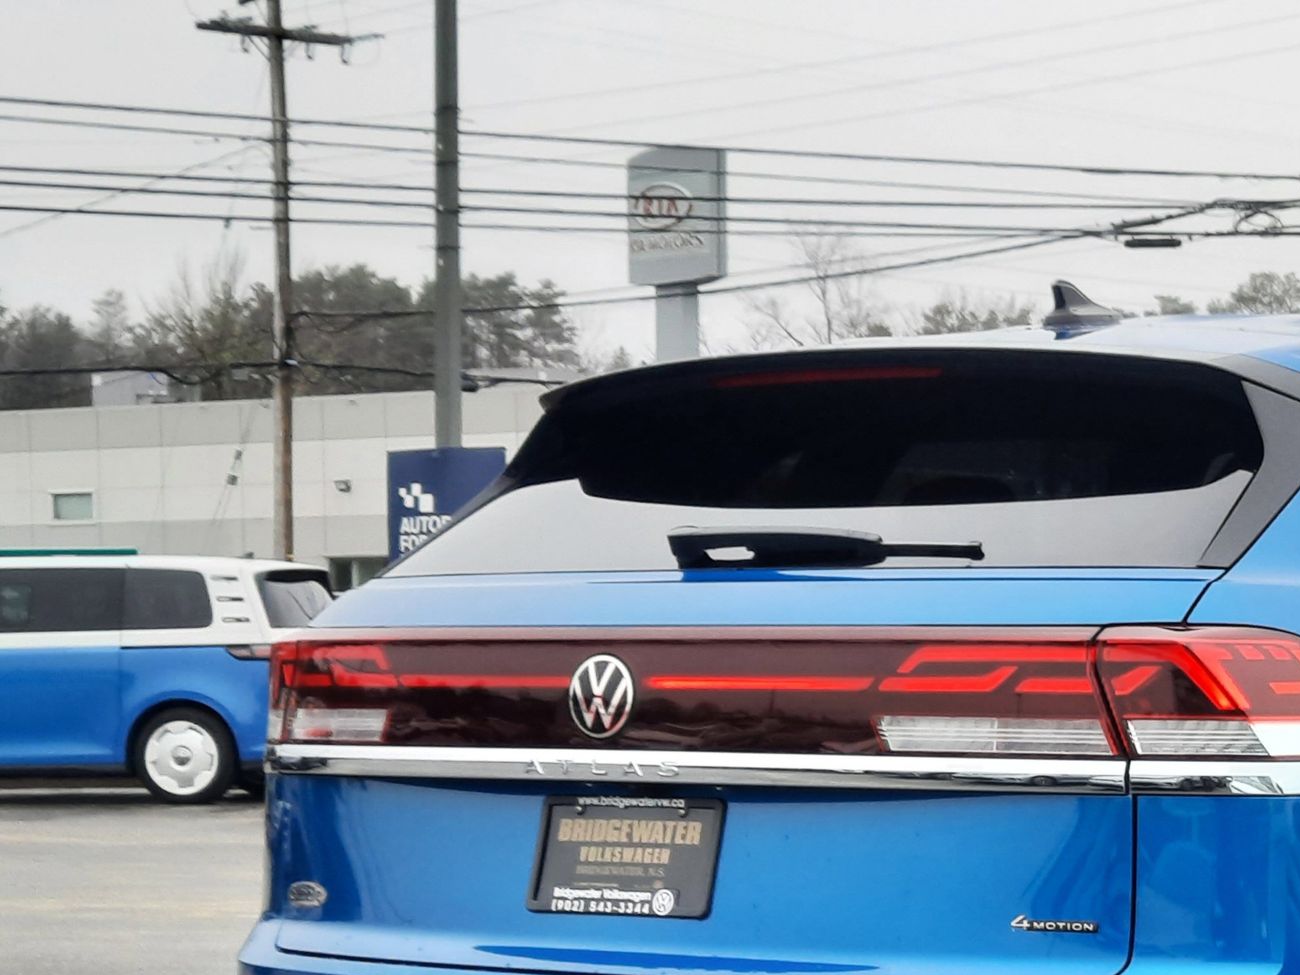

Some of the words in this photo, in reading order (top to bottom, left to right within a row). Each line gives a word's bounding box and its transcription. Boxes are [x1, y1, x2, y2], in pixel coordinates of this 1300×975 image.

[525, 759, 680, 777] ATLAS
[557, 818, 703, 846] BRIDGEWATER
[579, 846, 671, 864] VOLKSWAGEN
[551, 899, 585, 912] (902)
[588, 901, 650, 914] 543-3344
